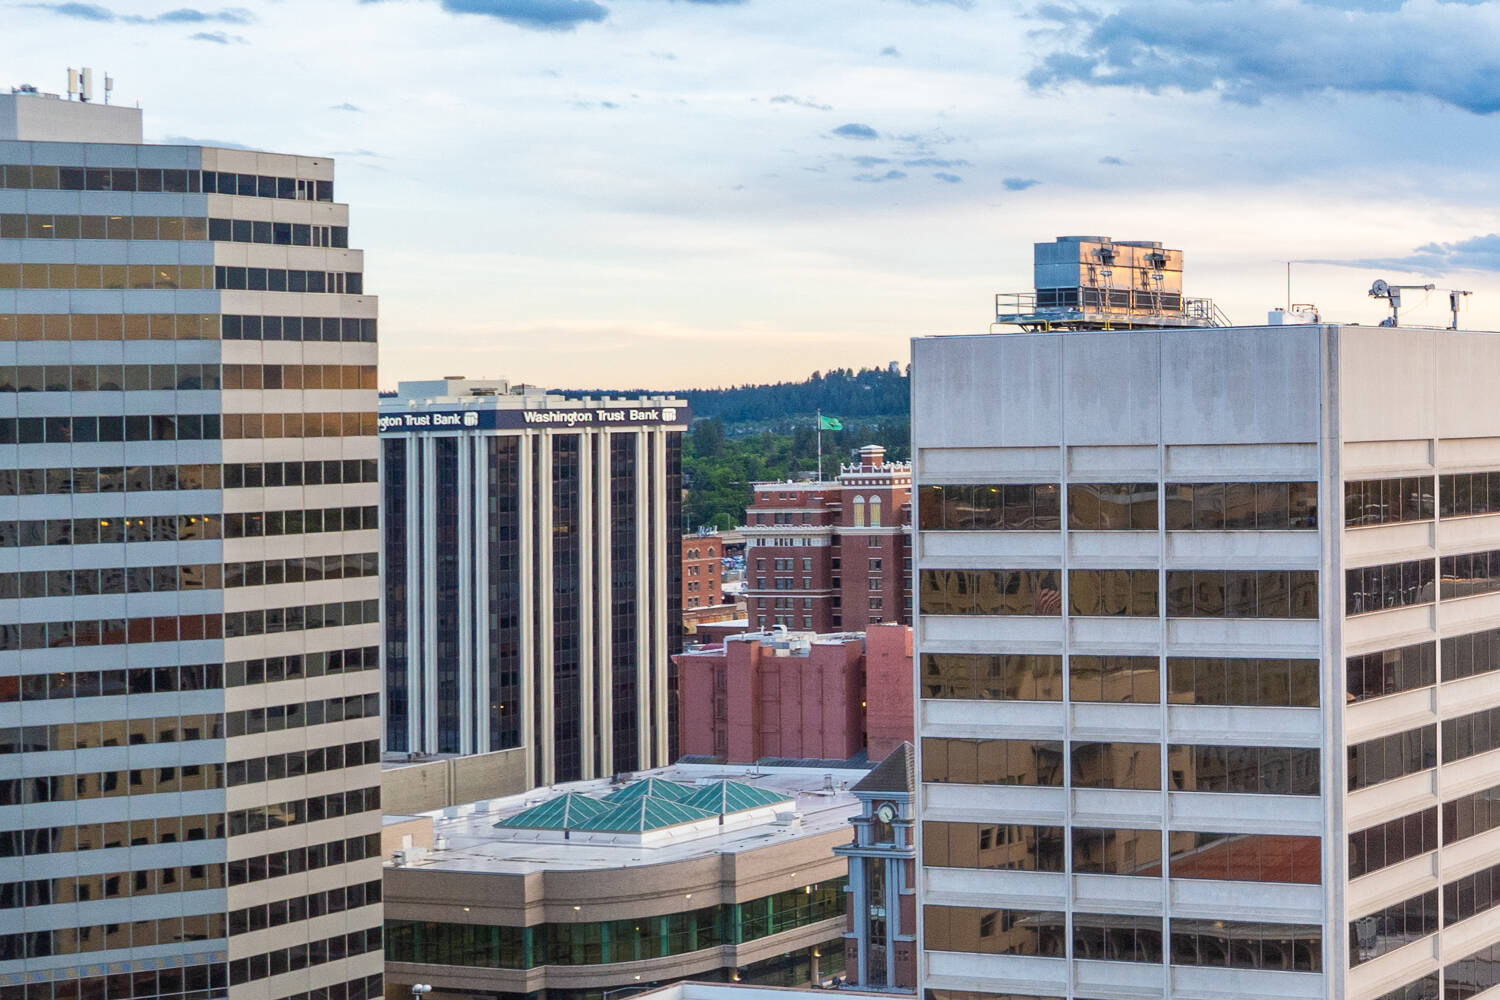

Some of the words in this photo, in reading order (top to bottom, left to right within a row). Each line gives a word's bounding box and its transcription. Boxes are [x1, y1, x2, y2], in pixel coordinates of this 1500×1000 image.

[404, 414, 430, 426] Trust
[433, 413, 461, 425] Bank
[523, 411, 592, 426] Washington
[596, 410, 625, 421] Trust
[629, 409, 659, 421] Bank
